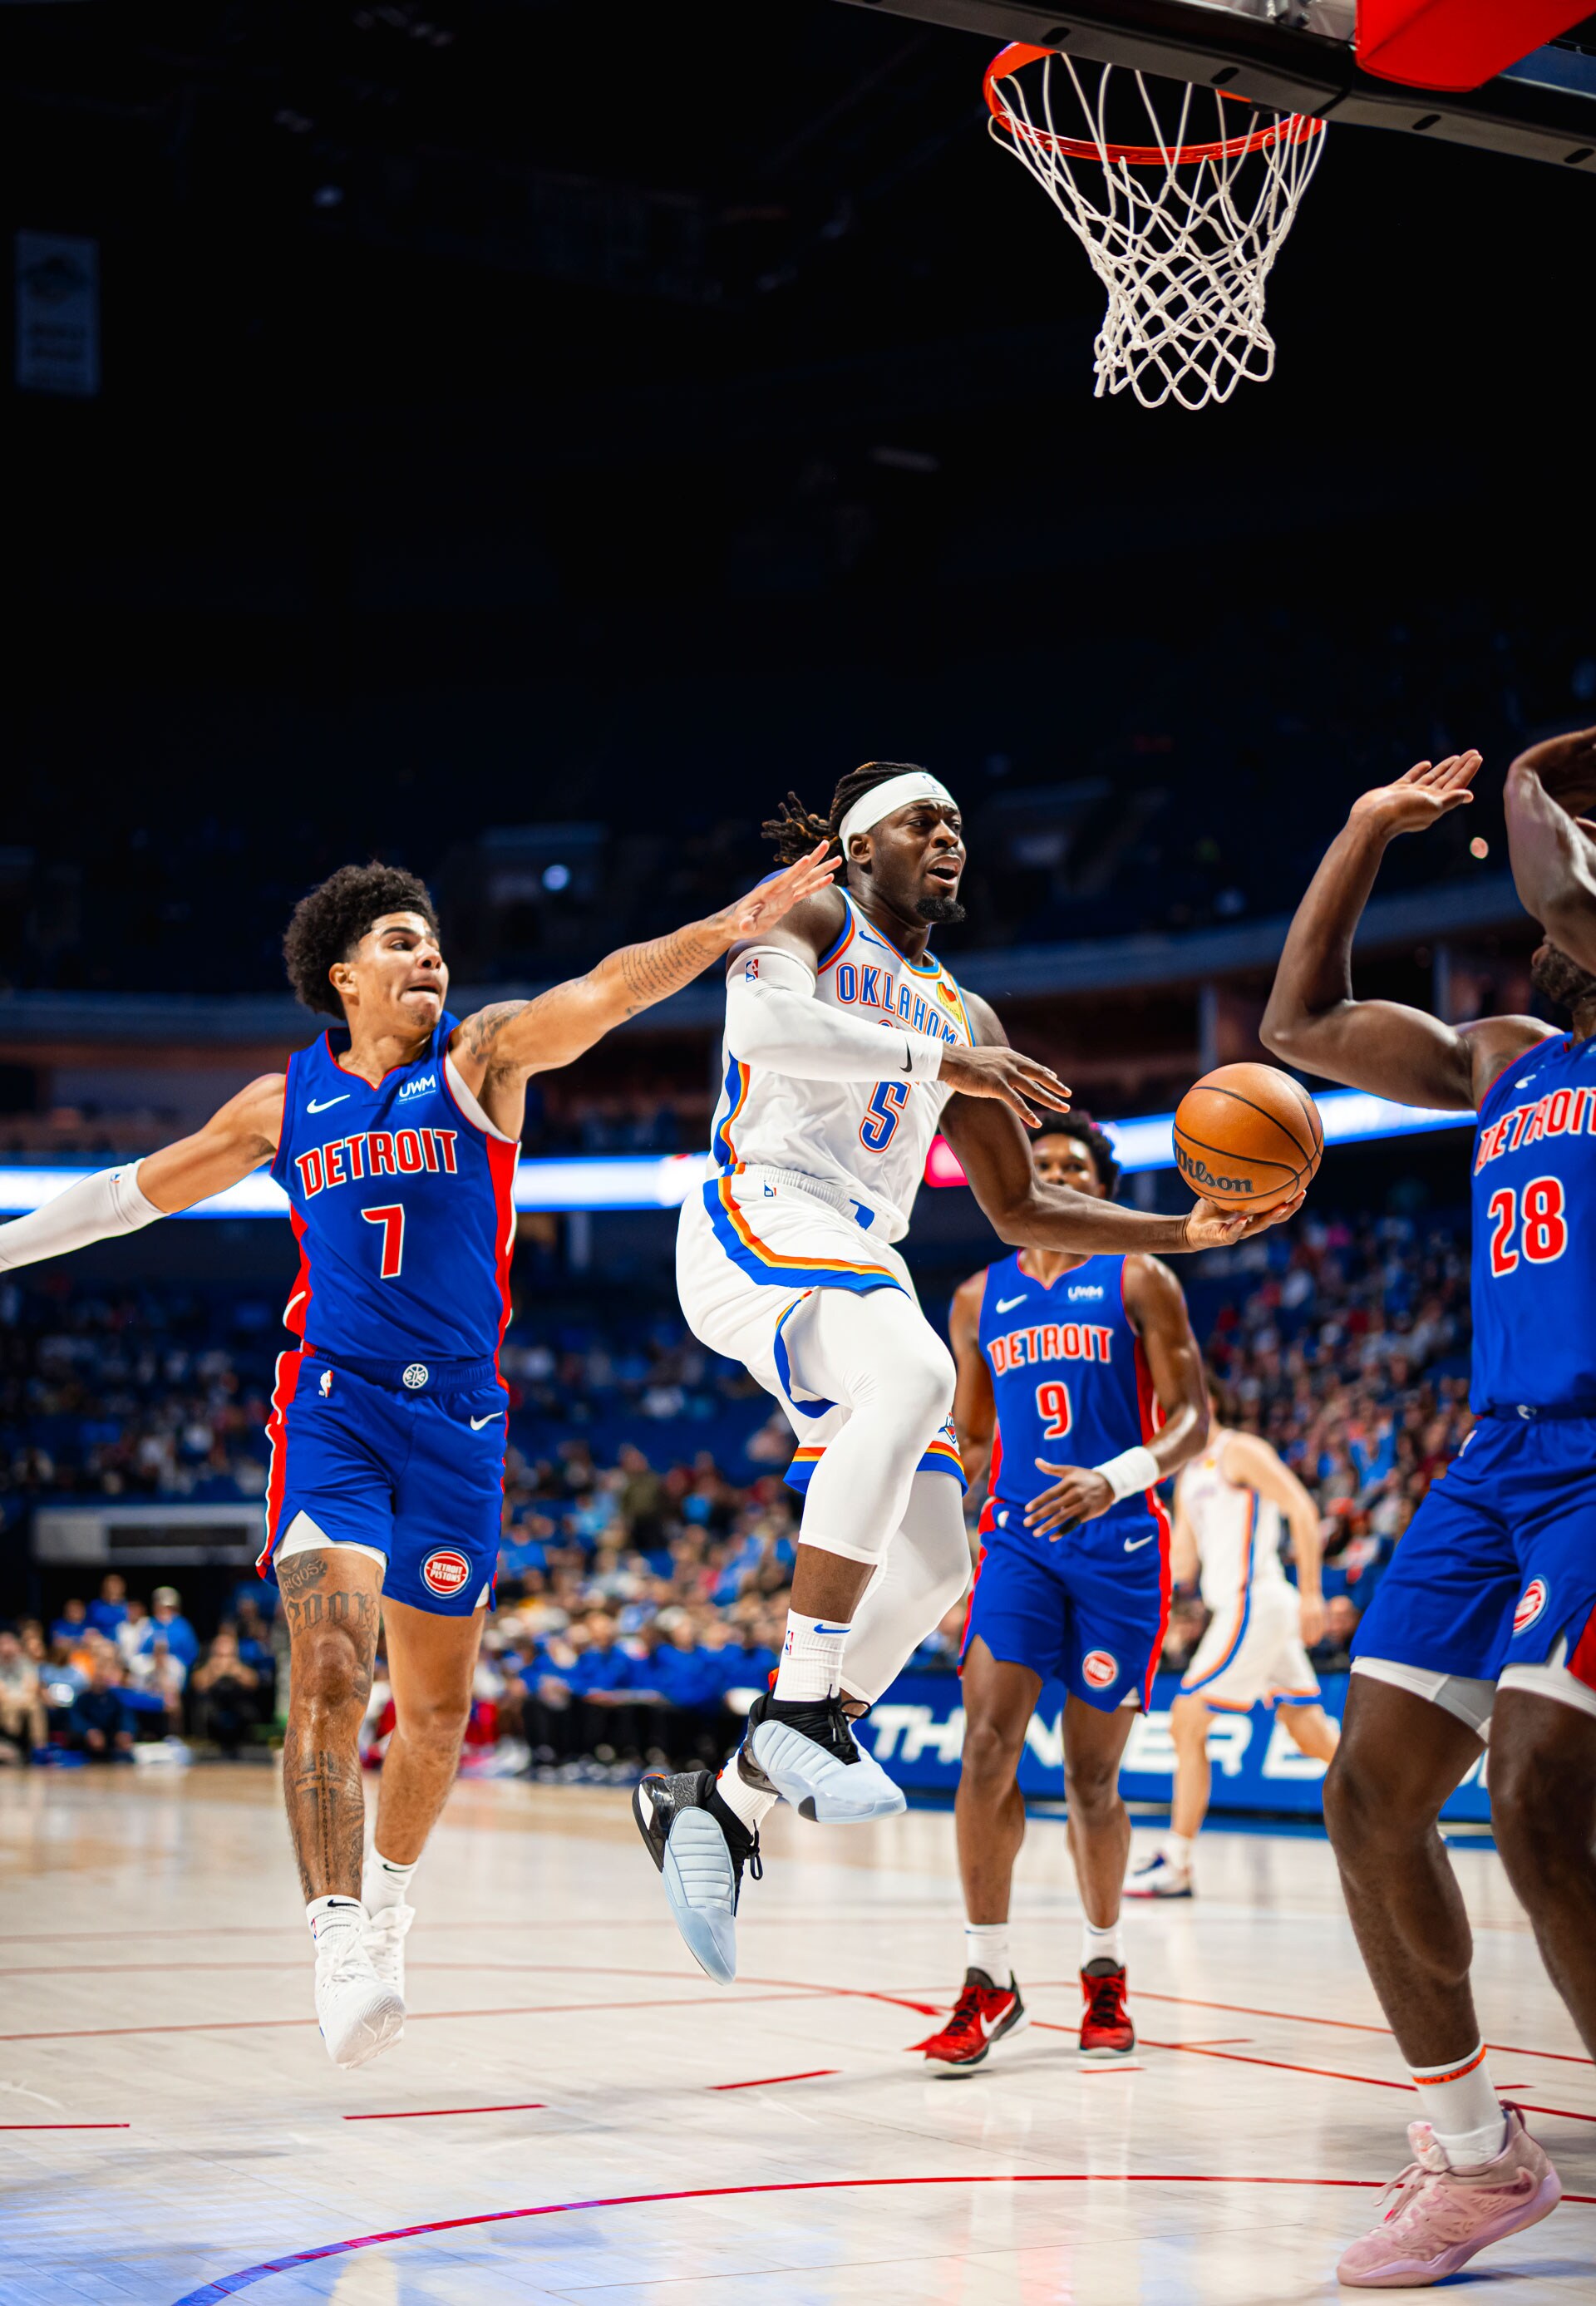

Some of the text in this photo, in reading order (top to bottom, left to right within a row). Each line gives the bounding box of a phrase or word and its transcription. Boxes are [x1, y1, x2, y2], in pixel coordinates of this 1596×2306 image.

[836, 963, 967, 1047] OKLAHOM
[399, 1074, 436, 1097] UWM
[859, 1081, 912, 1153] 5
[295, 1128, 458, 1200] DETROIT
[1175, 1137, 1254, 1194] Wilson
[361, 1203, 406, 1279] 7
[1487, 1175, 1568, 1278] 28
[987, 1323, 1114, 1377] DETROIT
[1036, 1381, 1073, 1440] 9
[430, 1569, 461, 1584] PISTONS
[431, 1561, 463, 1574] DETROIT
[869, 1702, 1253, 1777] THNER
